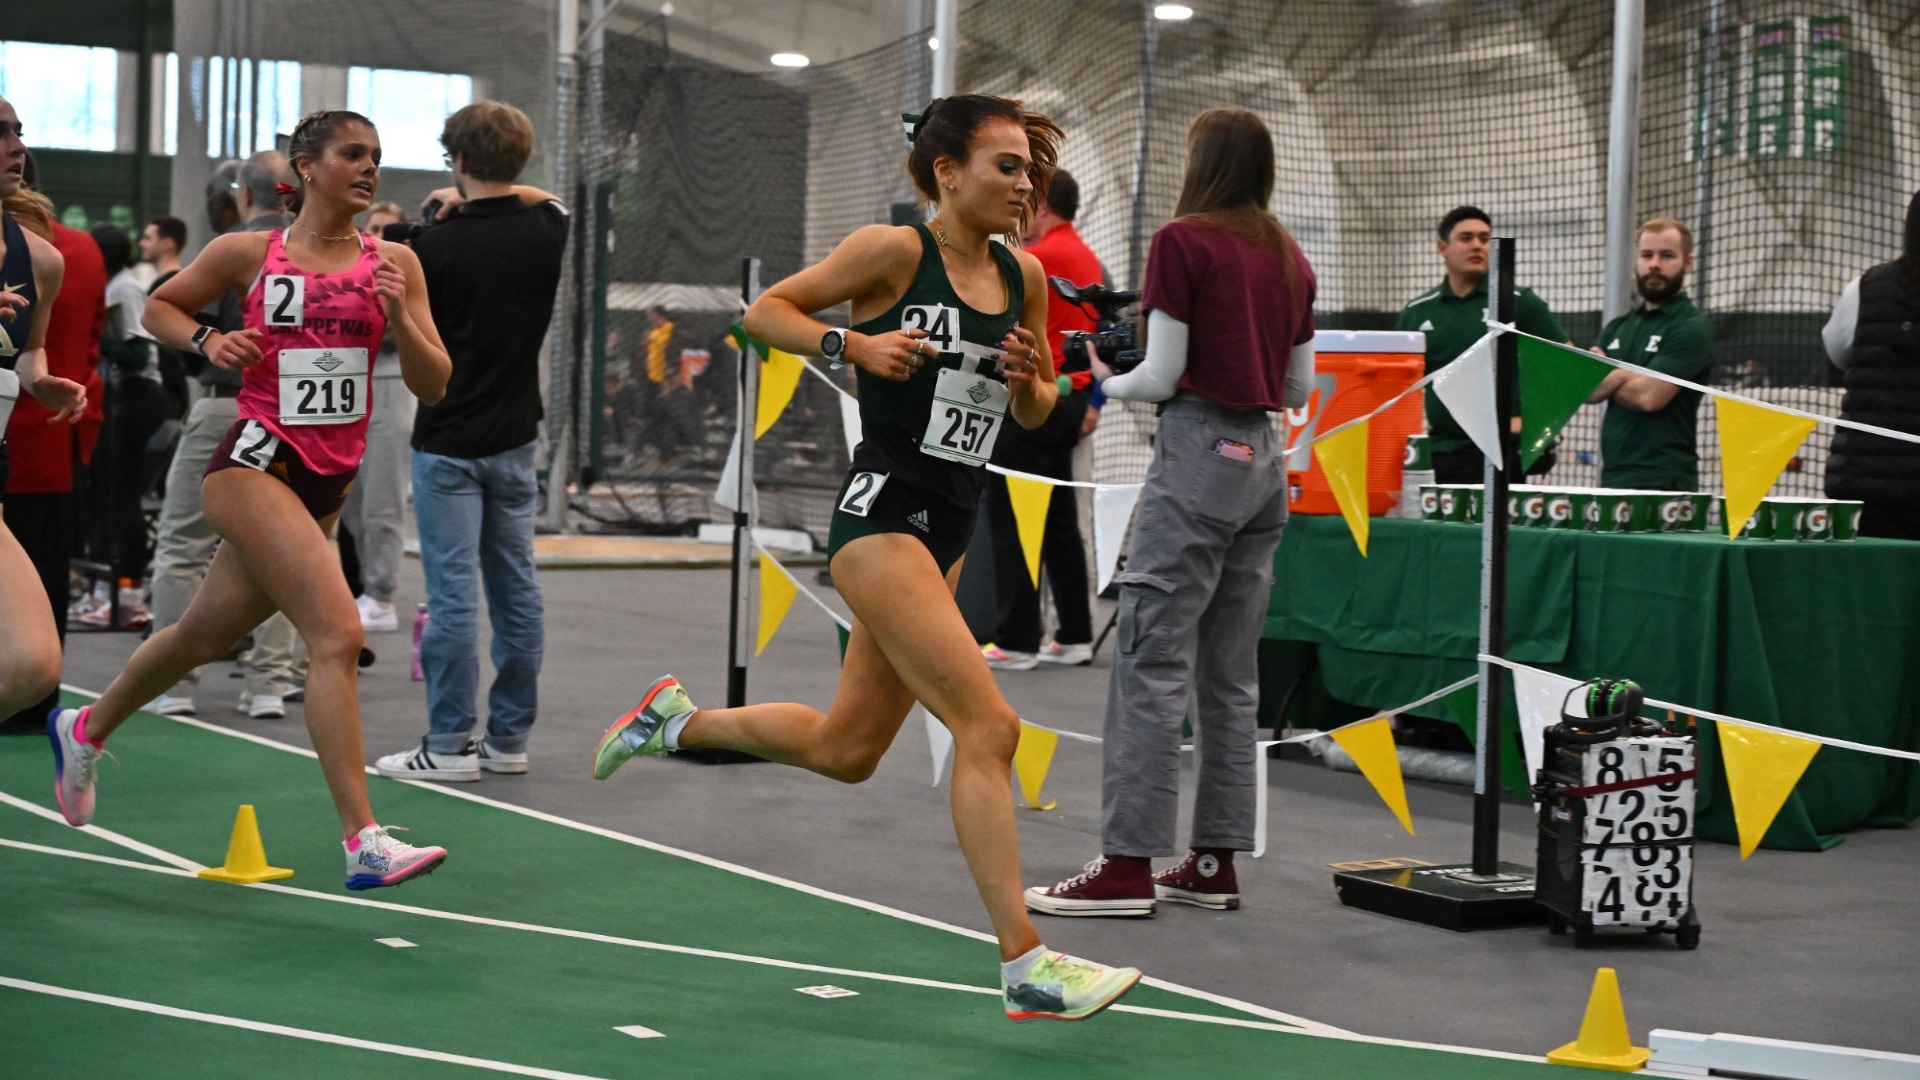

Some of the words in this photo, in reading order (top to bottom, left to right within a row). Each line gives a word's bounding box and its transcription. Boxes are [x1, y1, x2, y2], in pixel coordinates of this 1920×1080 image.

[272, 277, 296, 323] 2
[268, 317, 373, 337] PPEWAS
[1644, 335, 1663, 353] E
[296, 378, 356, 415] 219
[239, 422, 273, 467] 2
[940, 407, 995, 454] 257
[843, 473, 874, 514] 2
[1421, 492, 1438, 513] G
[1524, 497, 1544, 519] G
[907, 515, 930, 533] adidas
[1549, 498, 1569, 521] G
[1615, 501, 1631, 523] G
[1661, 501, 1679, 523] G
[1806, 509, 1827, 532] G
[1596, 746, 1625, 788] 8
[1658, 747, 1684, 793] 5
[1630, 821, 1660, 867] 8
[358, 850, 392, 872] HOKA
[1653, 845, 1681, 889] 3
[1597, 876, 1625, 922] 4
